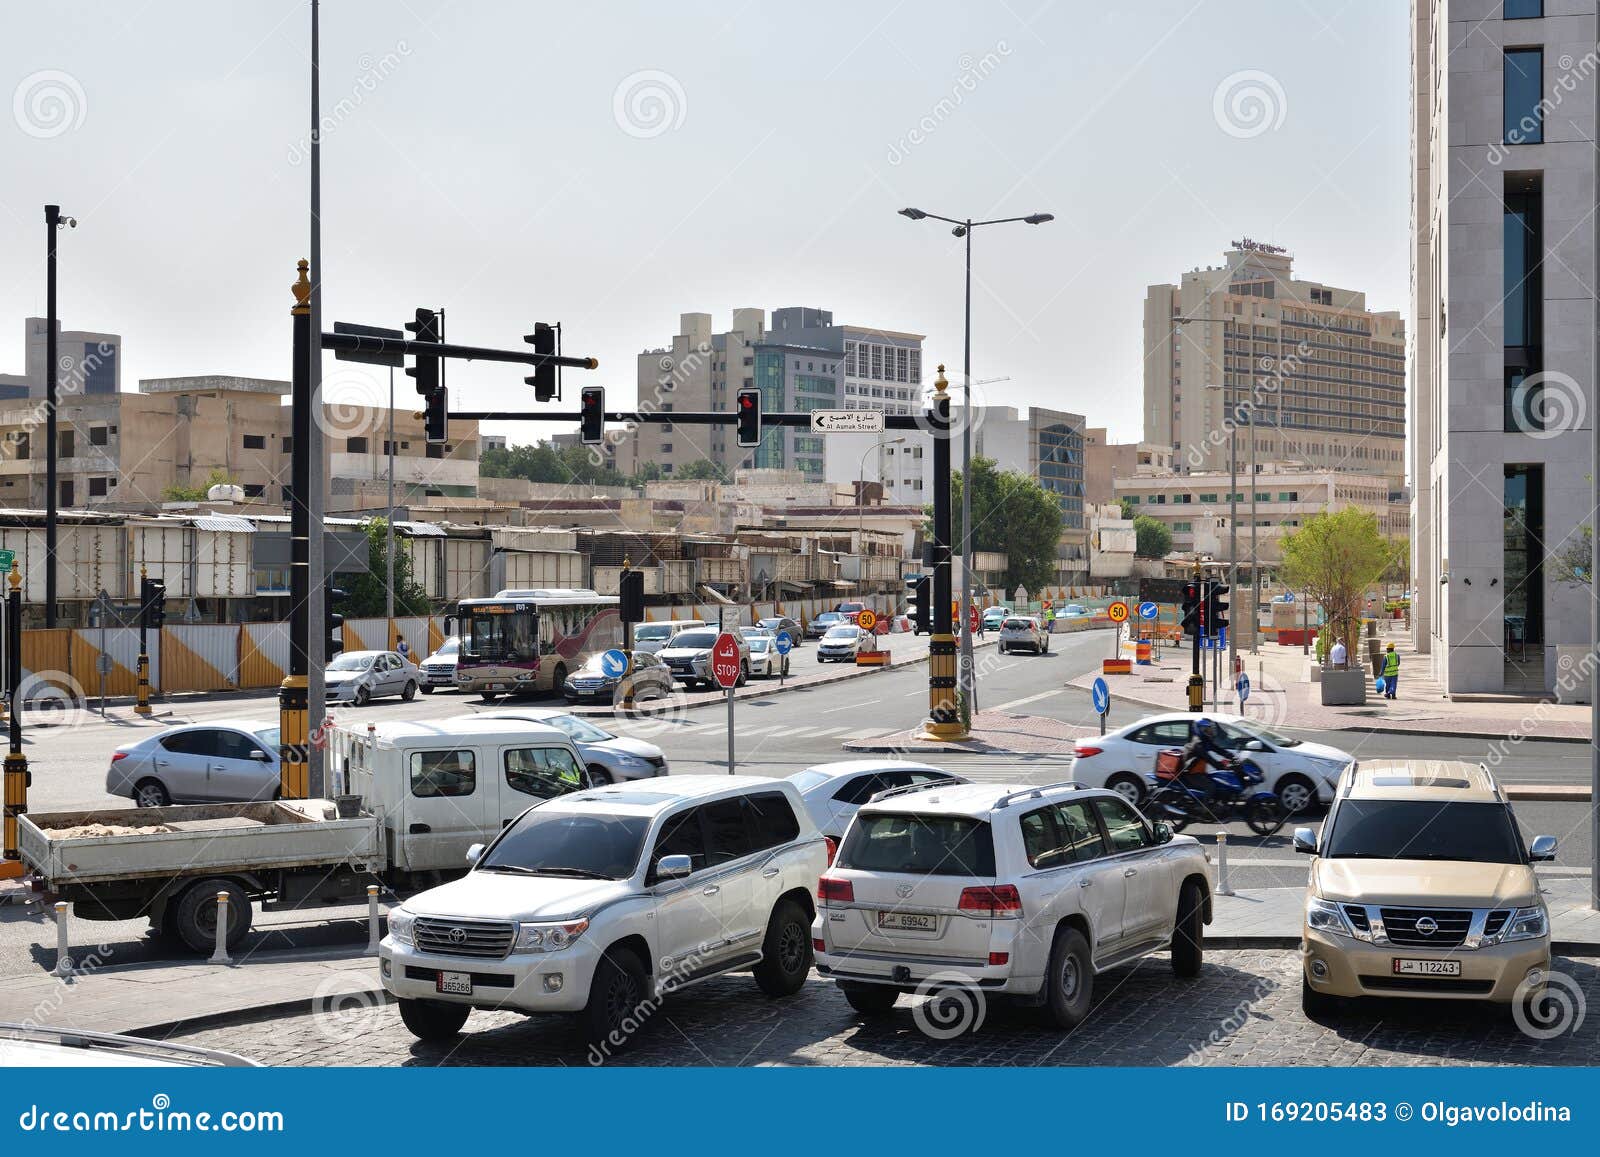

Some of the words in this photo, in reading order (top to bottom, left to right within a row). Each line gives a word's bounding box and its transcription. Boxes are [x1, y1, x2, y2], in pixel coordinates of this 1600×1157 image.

[1113, 607, 1124, 617] 50
[862, 614, 872, 625] 50
[717, 664, 737, 677] STOP
[901, 916, 929, 927] 69942
[1419, 962, 1455, 973] 112243
[443, 981, 470, 992] 365266
